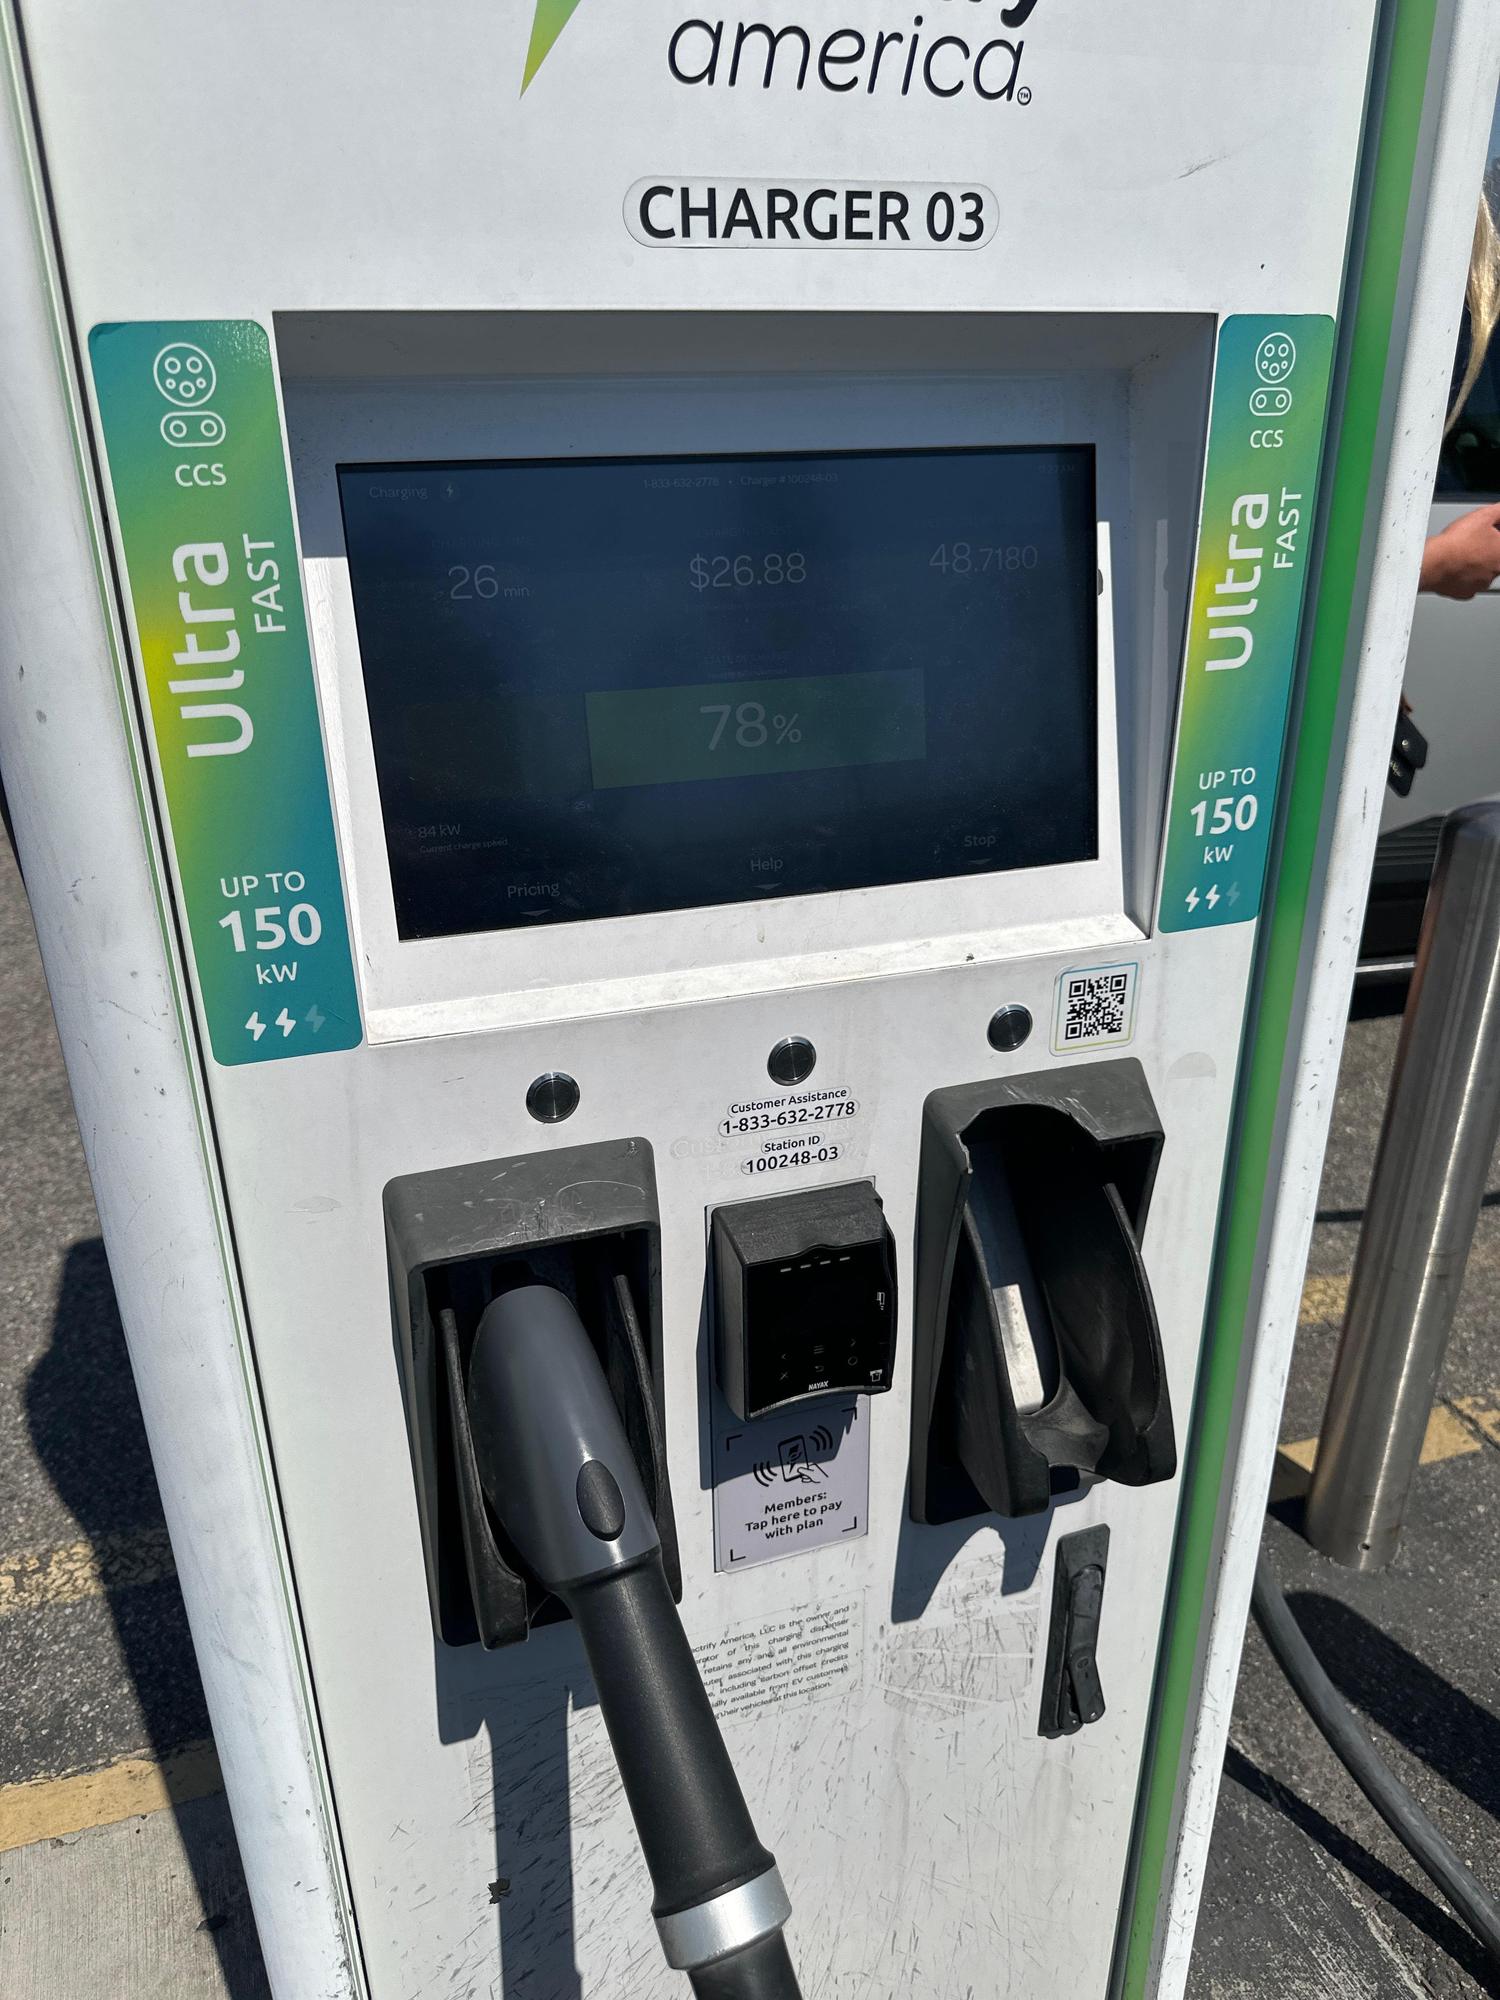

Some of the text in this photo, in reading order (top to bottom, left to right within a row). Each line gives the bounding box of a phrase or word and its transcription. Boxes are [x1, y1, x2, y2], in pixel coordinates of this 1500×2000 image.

[668, 15, 1024, 102] america
[639, 185, 984, 242] CHARGER 03
[1250, 429, 1283, 448] CCS
[174, 463, 227, 487] CCS
[369, 485, 428, 500] Charging
[1273, 487, 1302, 569] FAST
[242, 533, 286, 633] FAST
[448, 564, 531, 600] 26 min
[689, 552, 807, 593] $26.88
[1205, 494, 1268, 671] Ultra
[168, 542, 254, 758] Ultra
[699, 701, 802, 751] 78%
[1199, 767, 1256, 790] UP TO
[1190, 794, 1258, 836] 150
[964, 834, 996, 847] Stop
[750, 856, 784, 871] Help
[1203, 845, 1233, 864] kW
[220, 871, 306, 898] UP TO
[507, 881, 560, 898] Pricing
[218, 903, 322, 953] 150
[256, 962, 298, 985] kW
[731, 1088, 848, 1114] Customer Assistance
[722, 1101, 856, 1135] 1-833-632-2778
[764, 1135, 821, 1153] Station ID
[746, 1146, 839, 1174] 100248-03
[808, 1380, 829, 1391] NAYAX
[764, 1491, 827, 1514] Members:
[745, 1501, 843, 1532] Tap here to pay
[765, 1518, 823, 1539] with plan
[692, 1642, 717, 1653] ctrify
[834, 1605, 849, 1615] and
